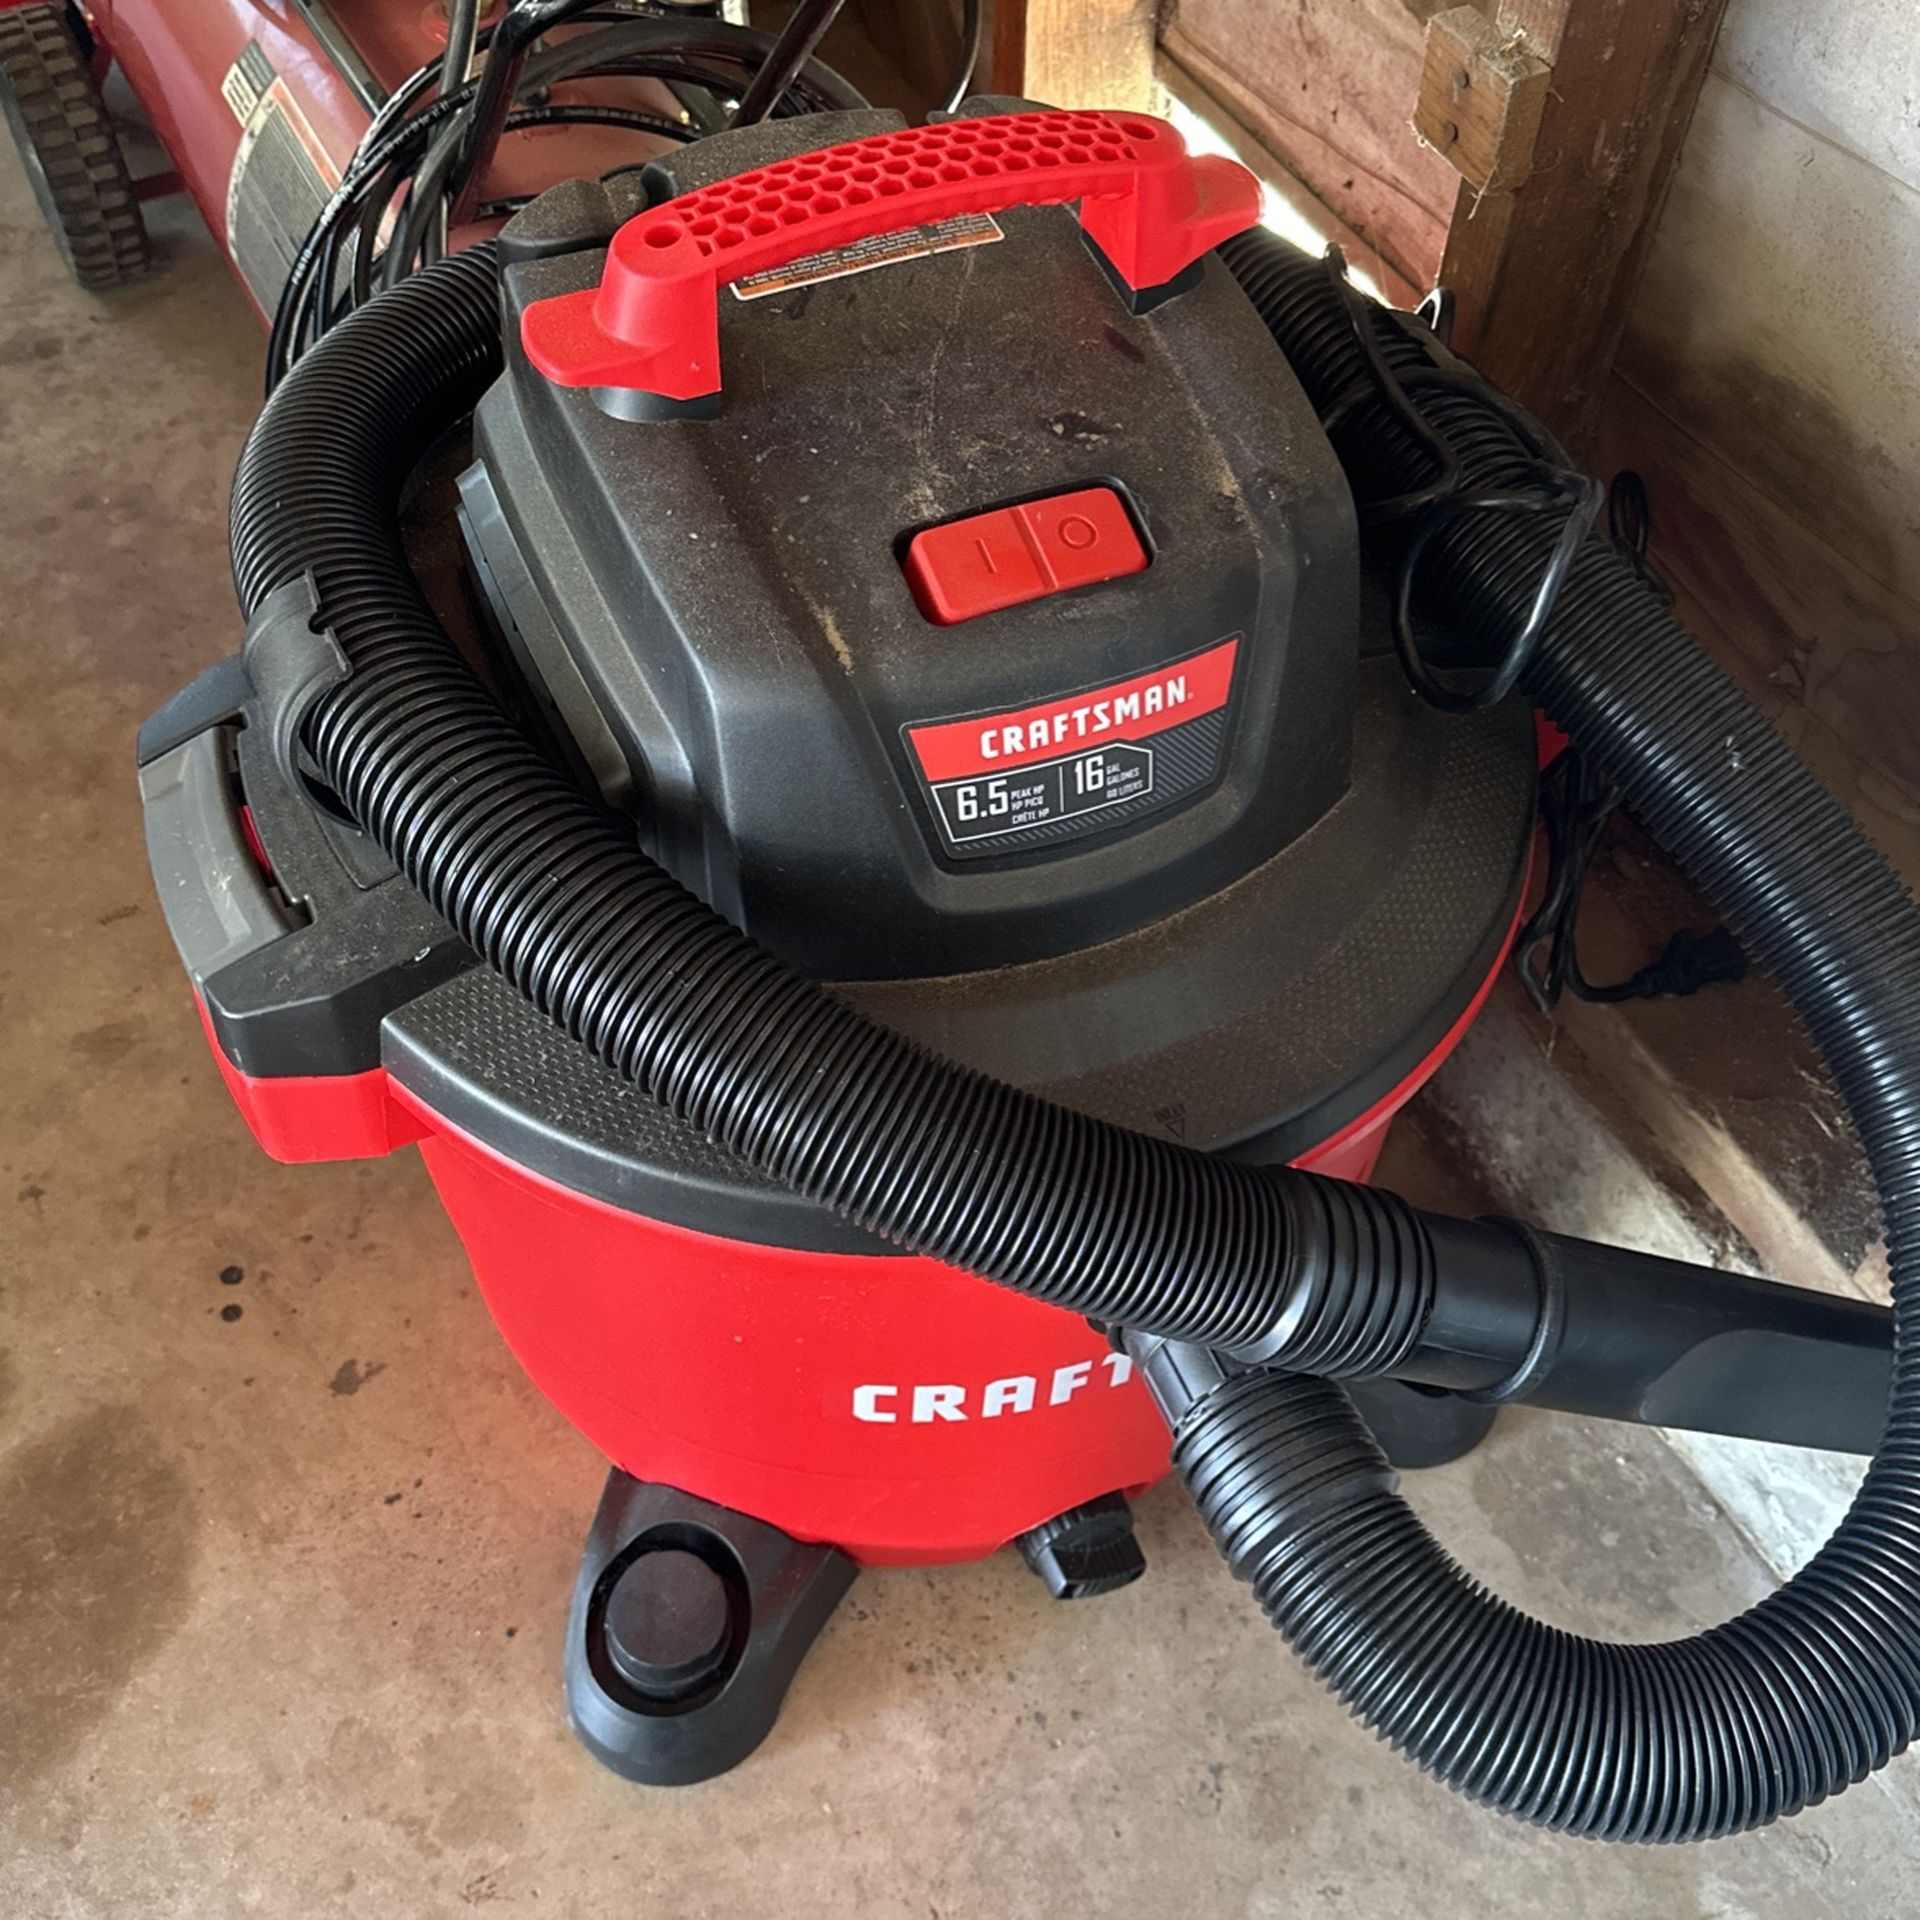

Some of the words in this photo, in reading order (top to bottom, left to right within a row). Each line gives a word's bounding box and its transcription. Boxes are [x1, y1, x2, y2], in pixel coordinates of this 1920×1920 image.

[980, 676, 1187, 759] CRAFTSMAN
[1074, 755, 1104, 795] 16
[956, 779, 1009, 821] 6.5
[1011, 787, 1031, 800] PEAK
[1033, 784, 1045, 795] HP
[1011, 800, 1023, 811] HP
[1038, 807, 1050, 818] HP
